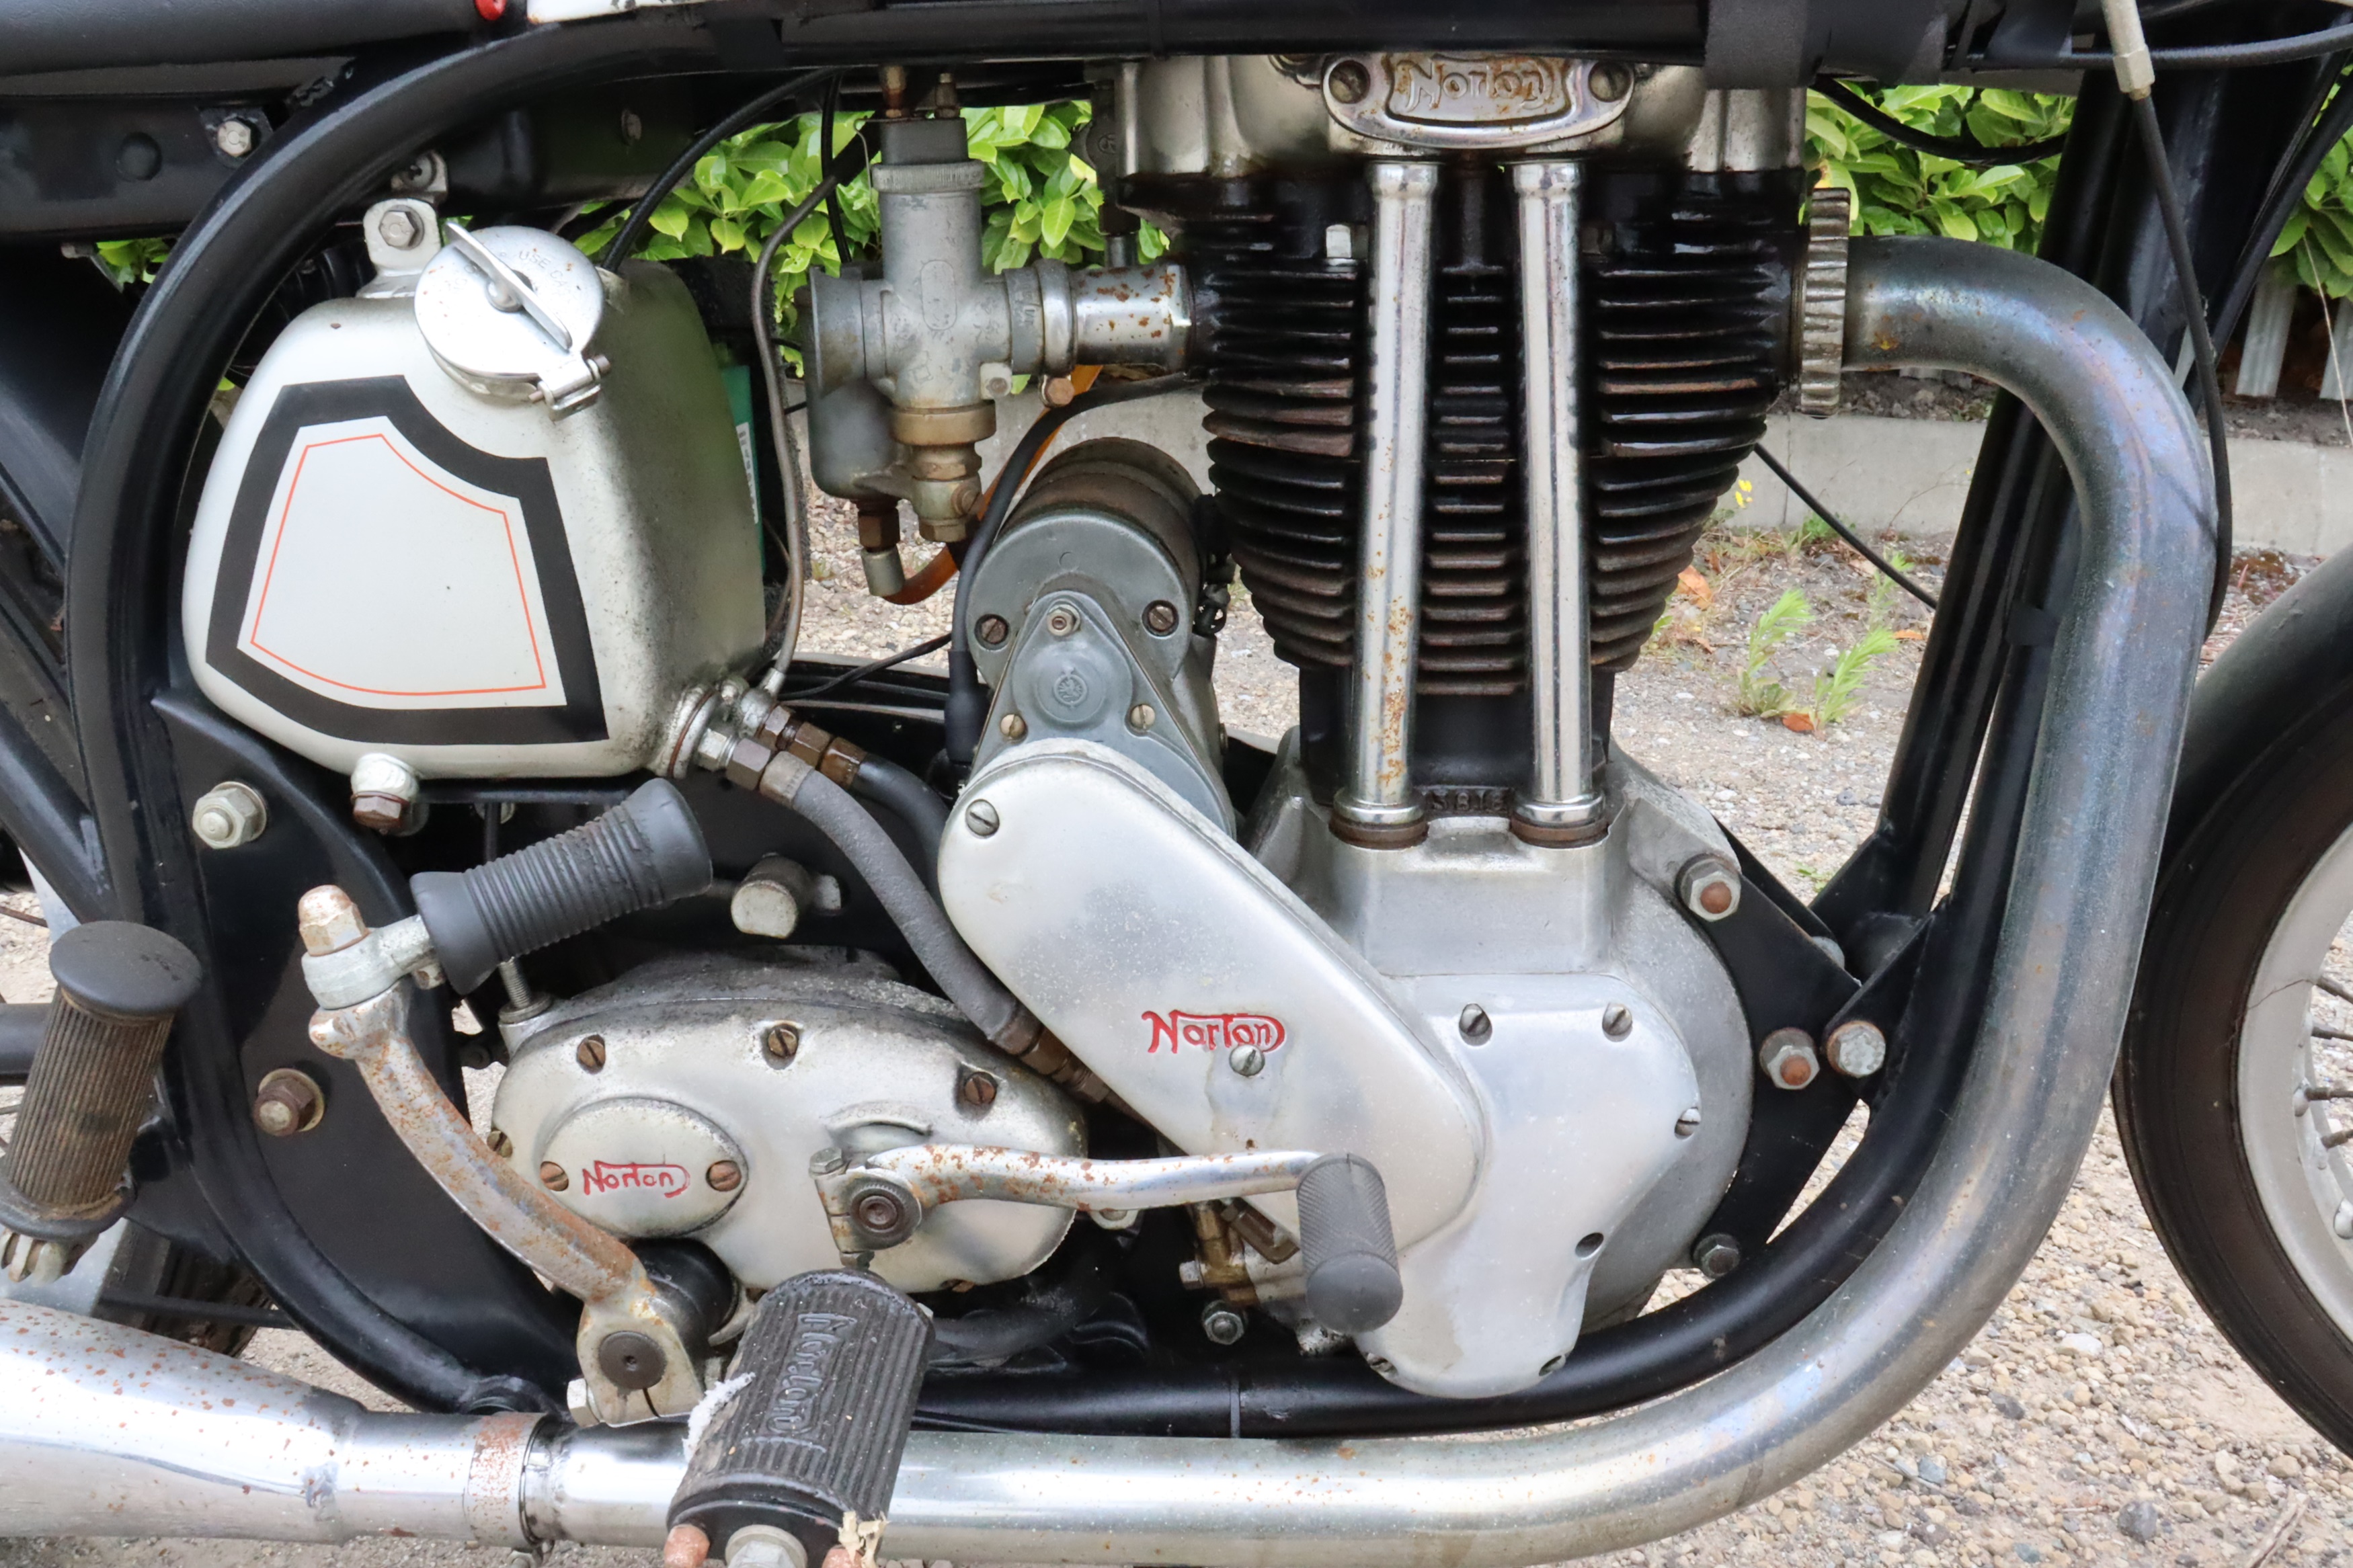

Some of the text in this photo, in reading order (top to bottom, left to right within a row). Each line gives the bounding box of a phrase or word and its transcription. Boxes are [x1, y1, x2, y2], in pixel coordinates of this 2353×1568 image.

[1396, 53, 1554, 113] Norton
[519, 251, 551, 269] USE
[1142, 1009, 1285, 1054] Norton
[582, 1160, 690, 1198] Norton
